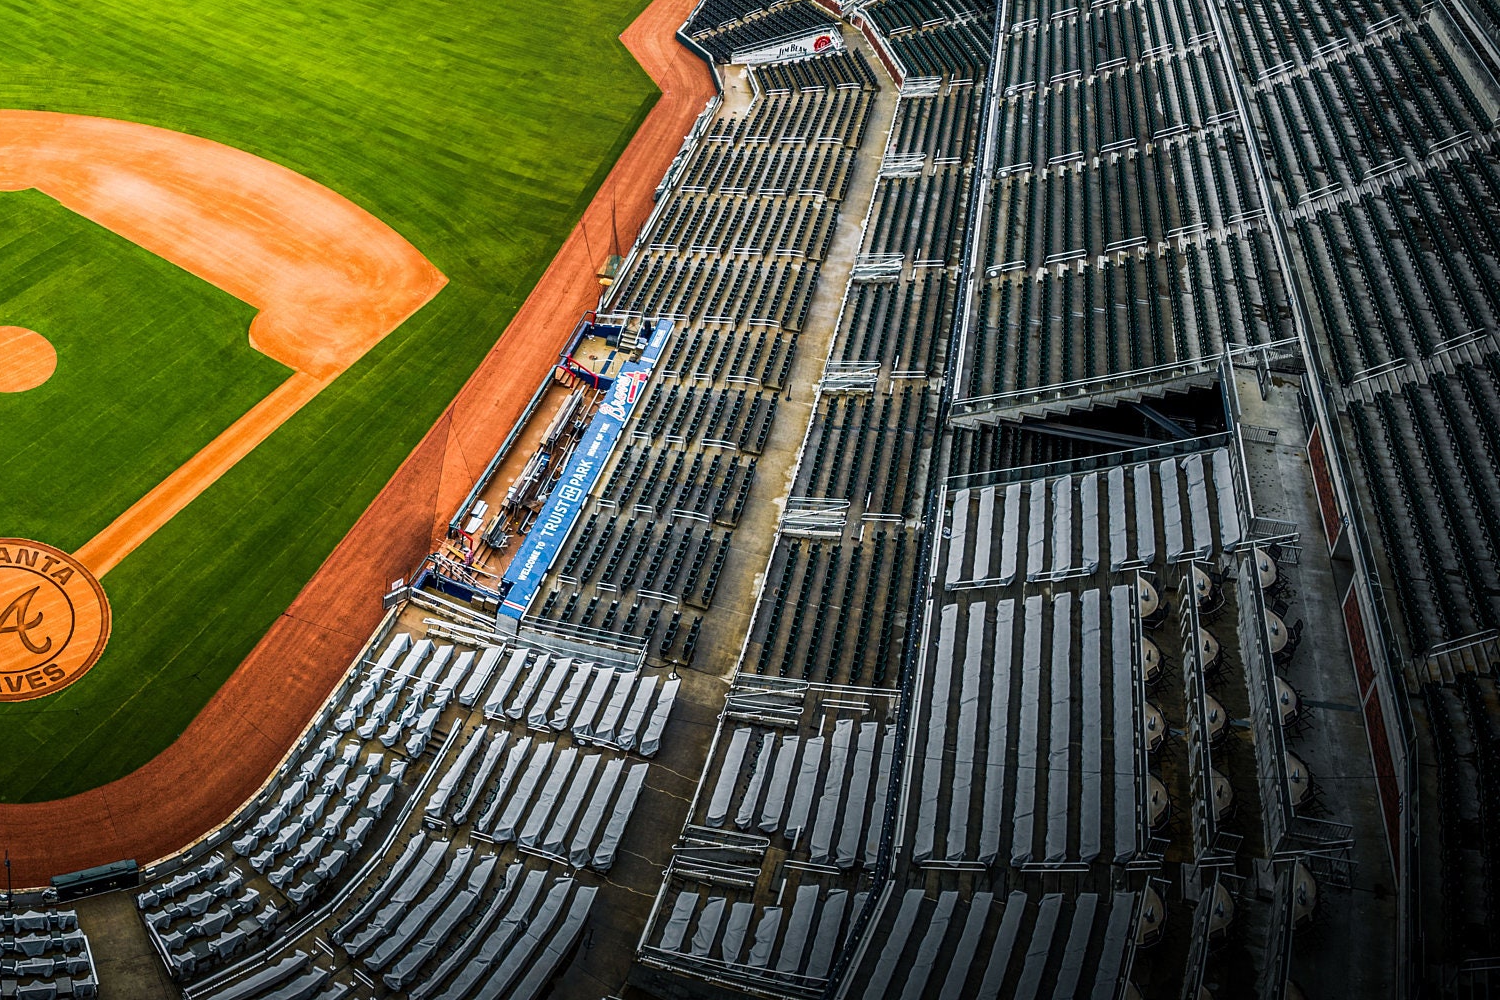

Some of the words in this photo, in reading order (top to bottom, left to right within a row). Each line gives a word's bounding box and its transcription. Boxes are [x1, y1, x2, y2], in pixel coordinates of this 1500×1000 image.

[599, 371, 632, 422] Braves
[541, 501, 570, 543] TRUIST
[572, 460, 593, 487] PARK
[517, 553, 539, 581] WELCOME
[537, 540, 546, 552] TO
